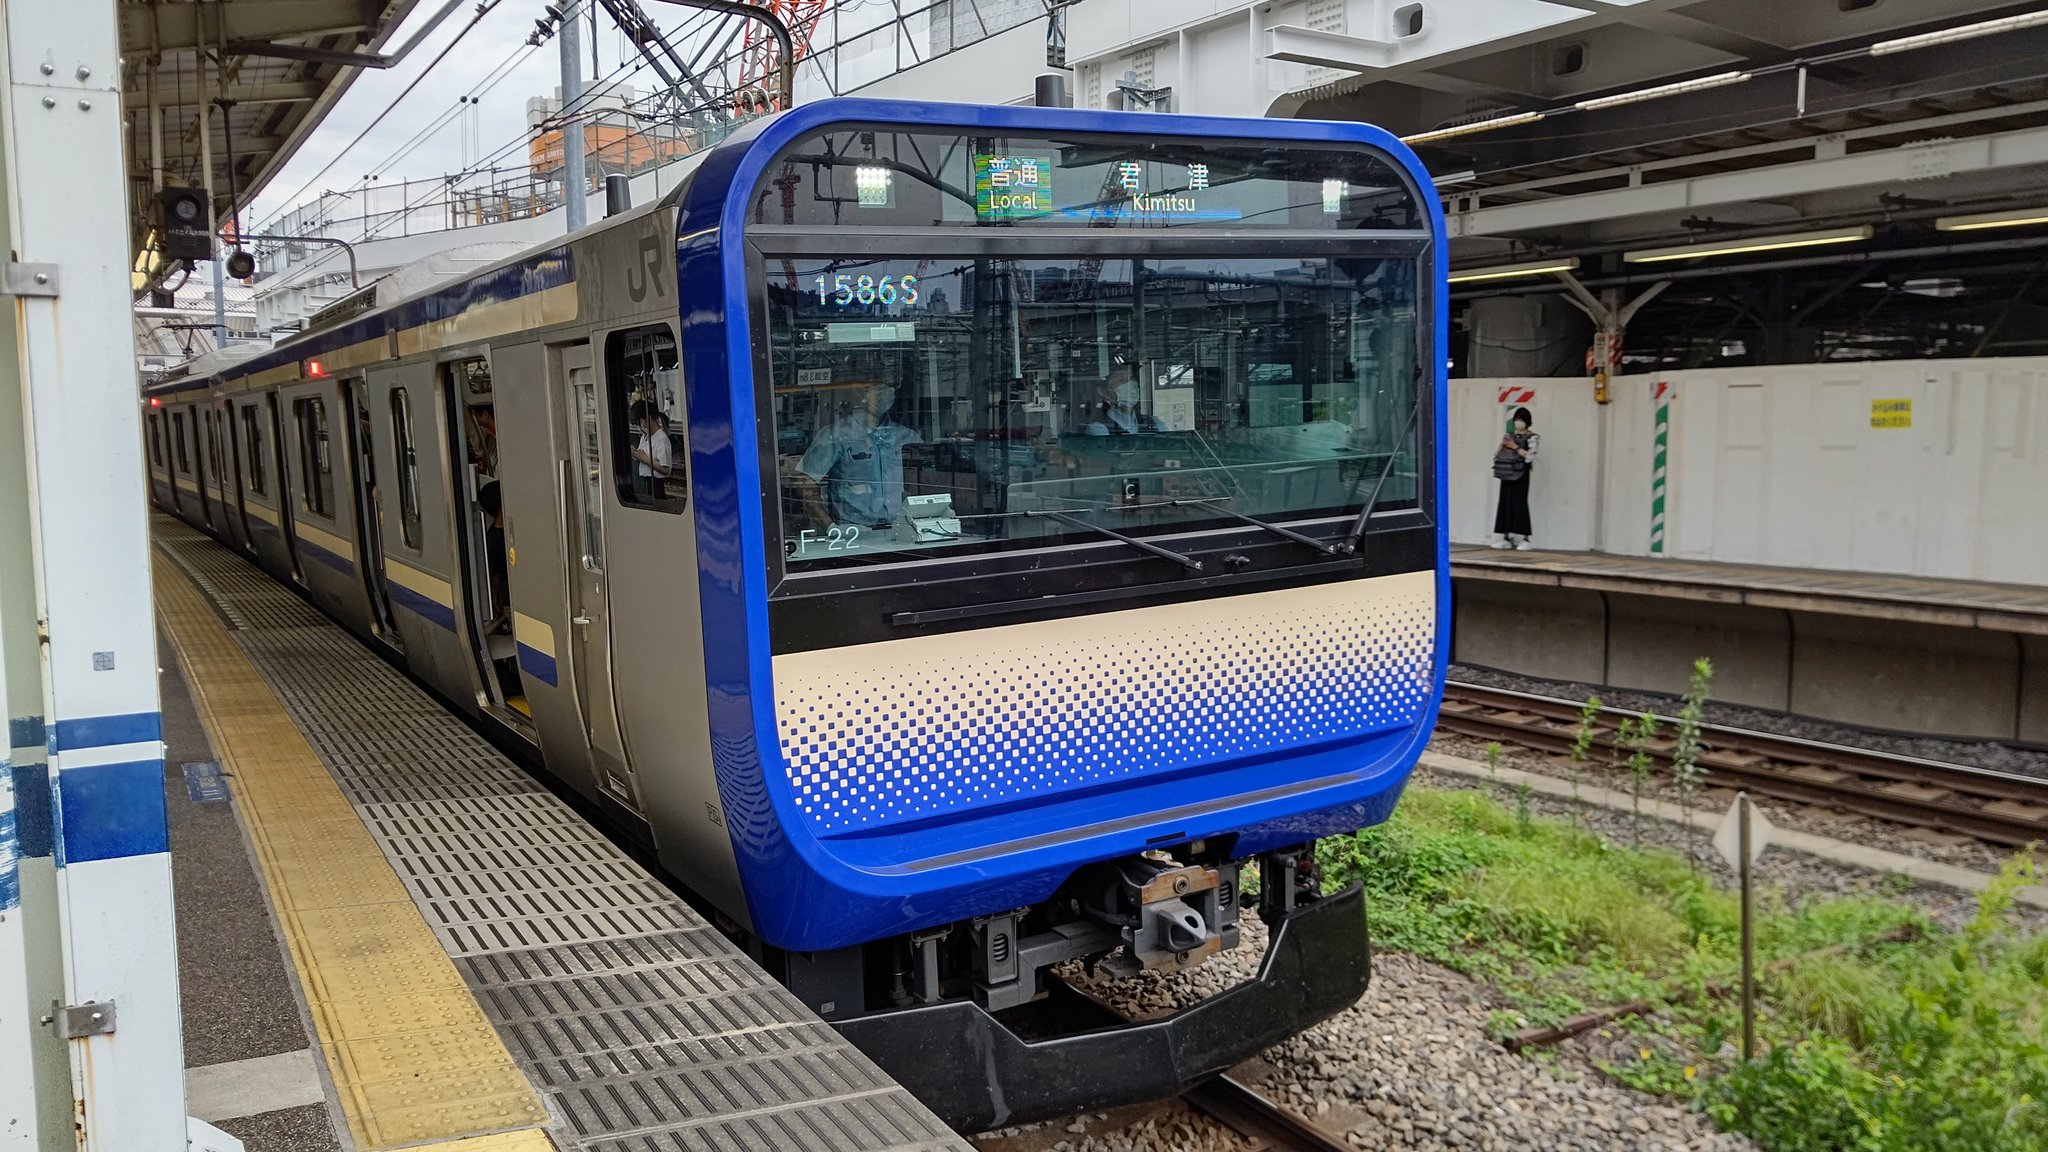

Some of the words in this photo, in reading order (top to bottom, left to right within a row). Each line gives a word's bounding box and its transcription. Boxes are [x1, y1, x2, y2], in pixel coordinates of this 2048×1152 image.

[988, 157, 1038, 188] 普通
[990, 191, 1038, 210] Local
[1133, 192, 1195, 212] Kimitsu
[627, 234, 665, 302] JR
[814, 274, 918, 306] 1586S
[801, 526, 860, 554] F-22
